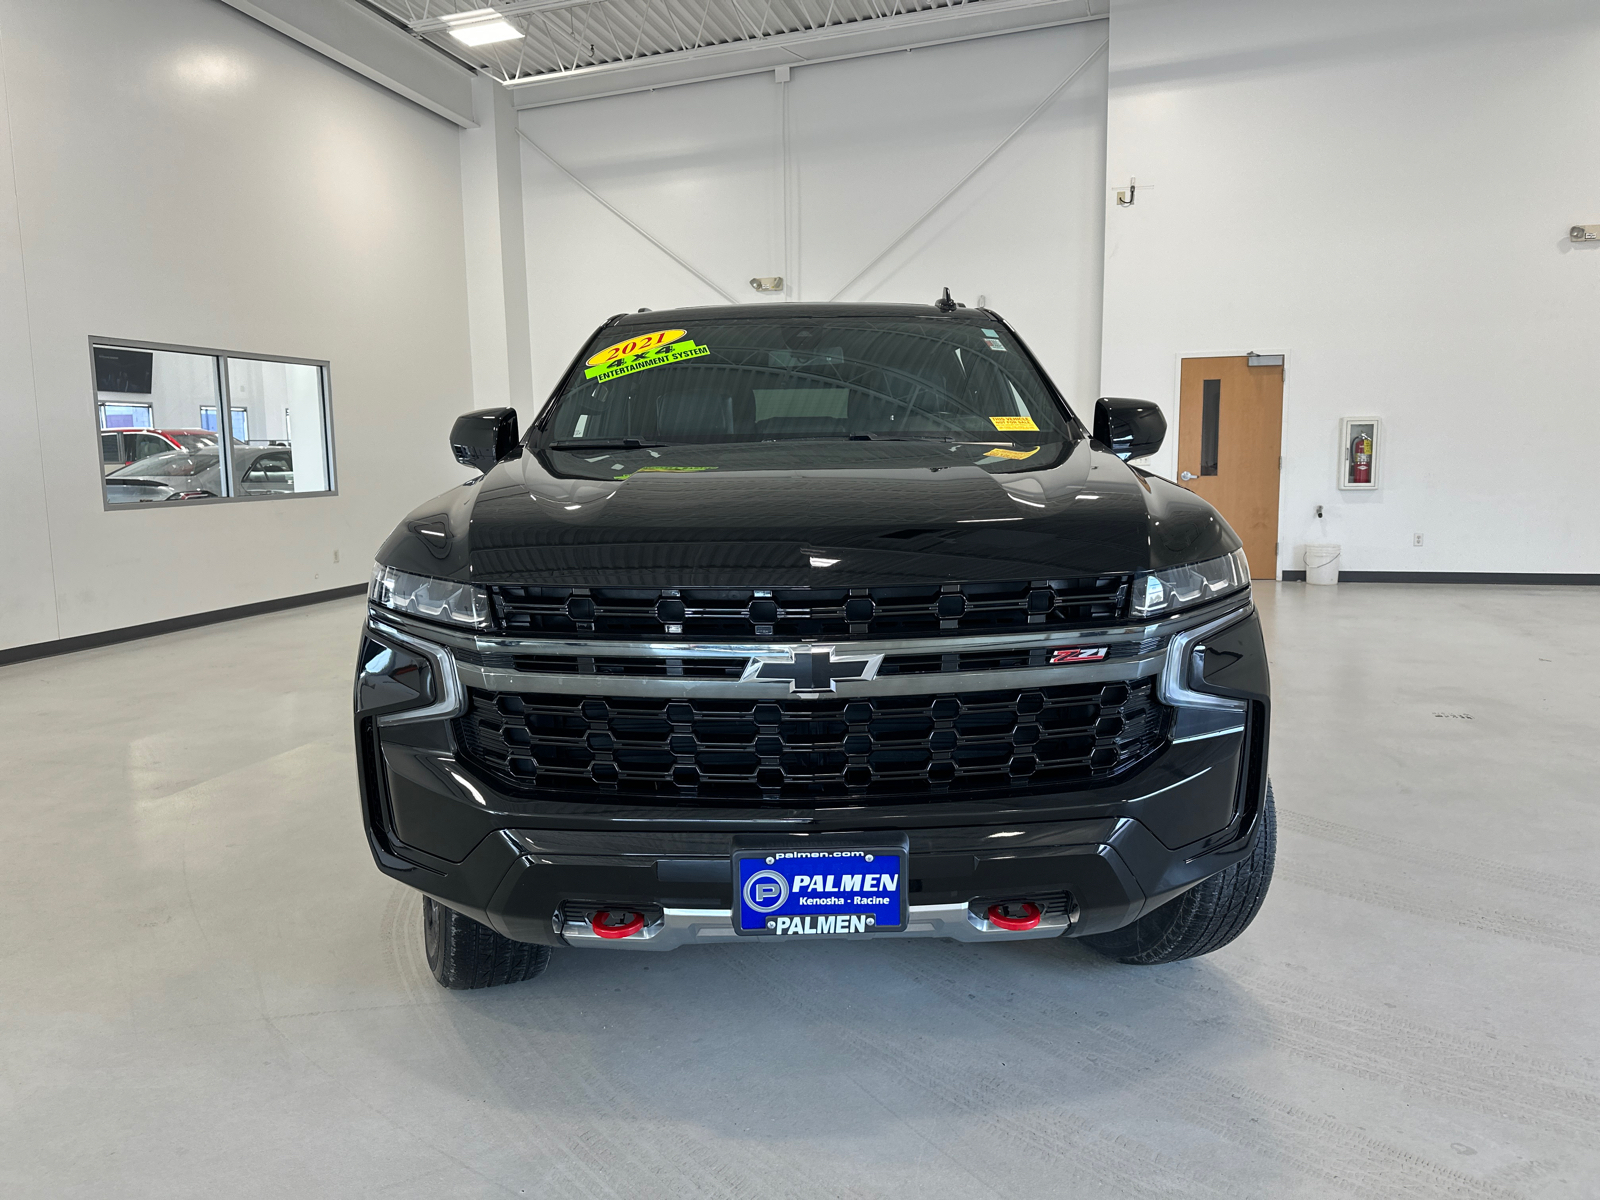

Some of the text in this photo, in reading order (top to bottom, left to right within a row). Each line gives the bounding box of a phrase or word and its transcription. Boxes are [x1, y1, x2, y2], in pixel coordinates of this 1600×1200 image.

[606, 332, 666, 361] 2021
[599, 347, 709, 381] ENTERTAINMENT SYSTEM
[775, 851, 864, 860] palmen.com
[792, 874, 899, 893] PALMEN
[799, 896, 845, 906] Kenosha
[853, 896, 890, 905] Racine
[776, 914, 867, 935] PALMEN
